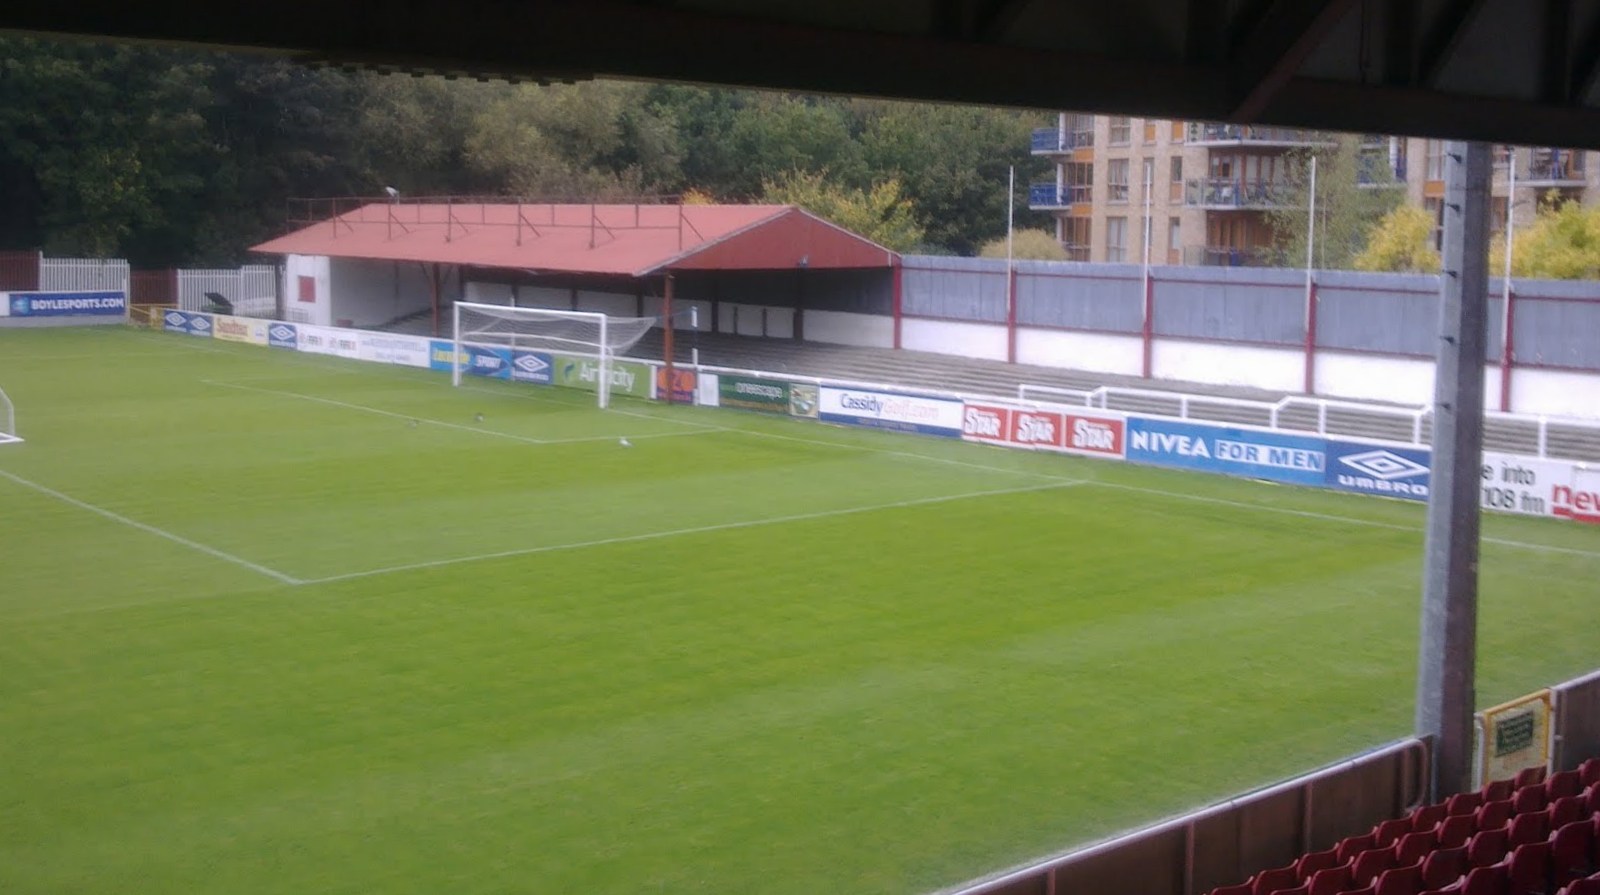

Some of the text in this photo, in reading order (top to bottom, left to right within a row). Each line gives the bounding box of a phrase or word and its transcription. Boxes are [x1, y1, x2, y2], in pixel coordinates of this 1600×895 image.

[31, 298, 124, 310] BOYLESPORTS.COM
[1131, 430, 1322, 470] NIVEA FOR MEN
[1502, 461, 1536, 485] into
